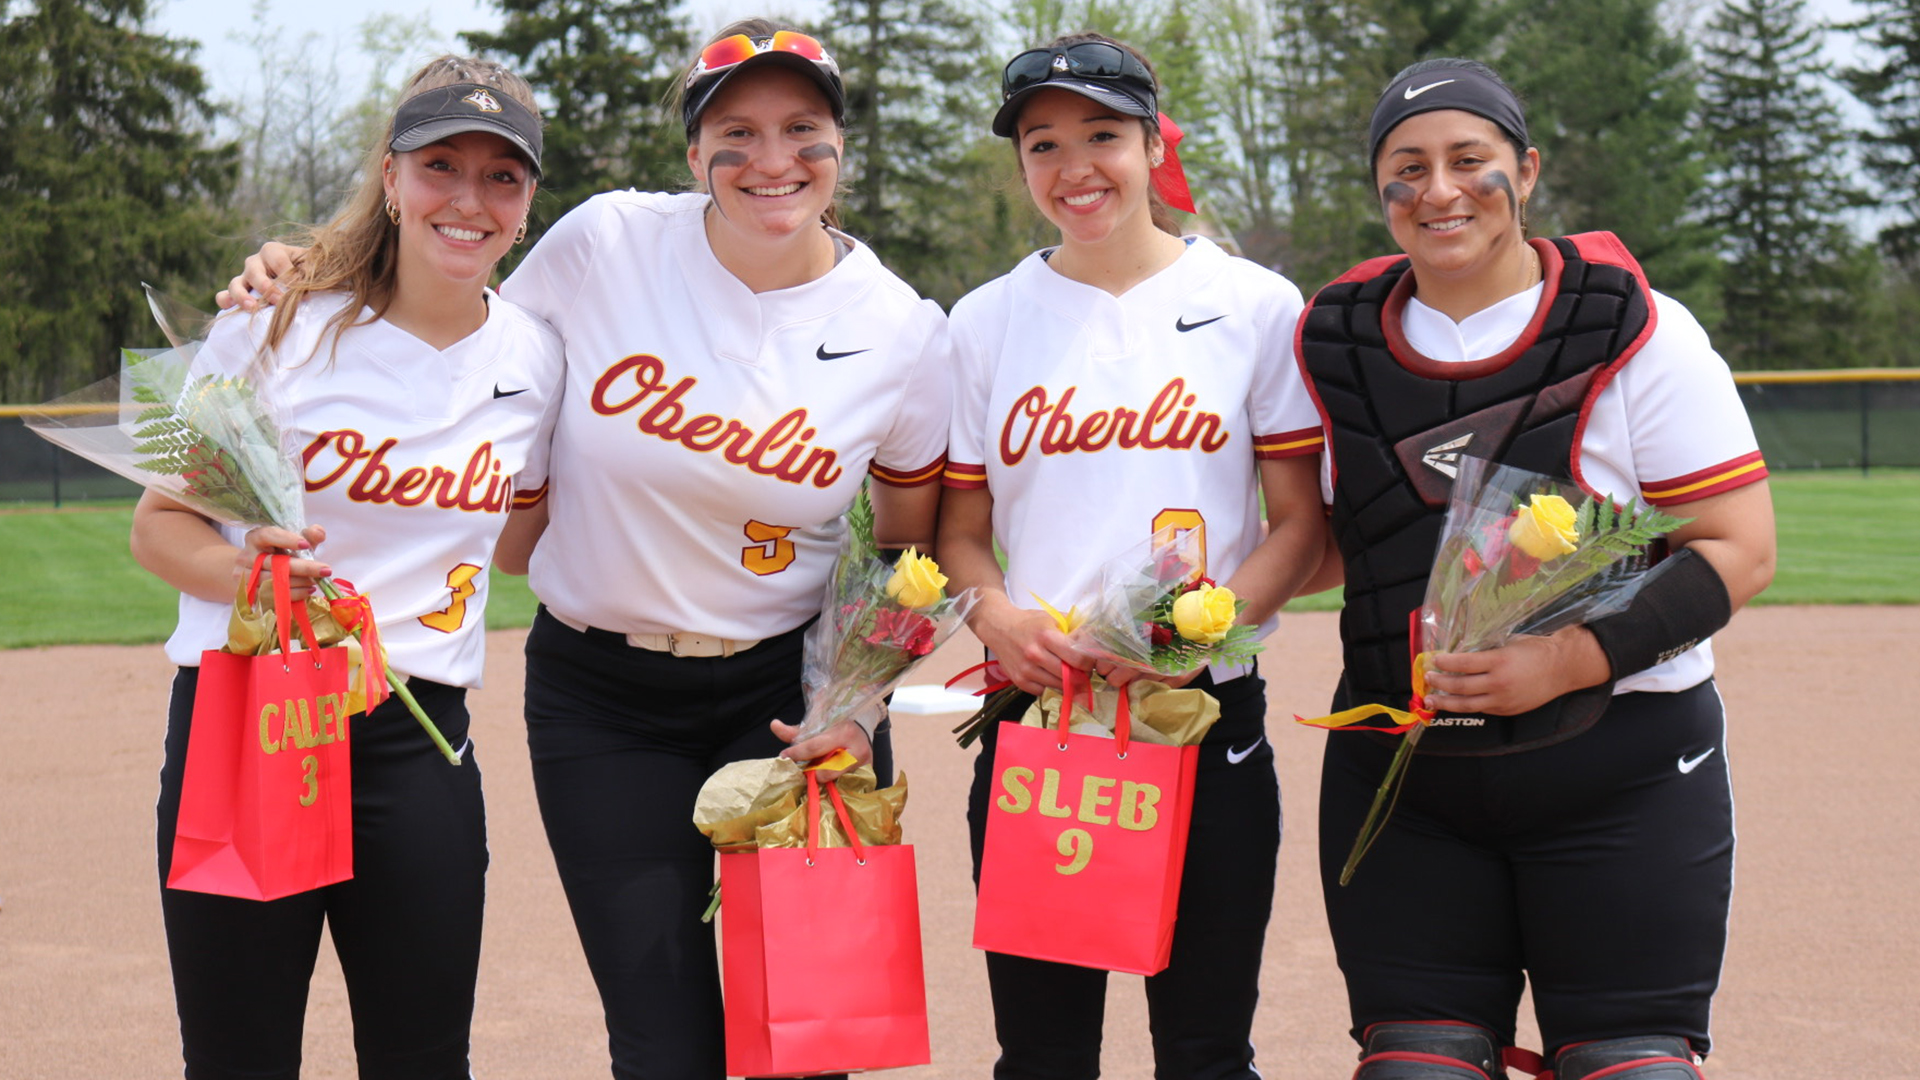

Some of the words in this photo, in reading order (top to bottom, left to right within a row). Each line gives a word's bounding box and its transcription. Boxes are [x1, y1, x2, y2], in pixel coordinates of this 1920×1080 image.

[590, 353, 843, 489] Oberlin
[1000, 376, 1229, 466] Oberlin
[417, 562, 483, 634] 3
[259, 691, 350, 754] CALEY
[1430, 717, 1485, 727] EASTON
[299, 755, 319, 807] 3
[997, 766, 1162, 831] SLEB
[1055, 828, 1094, 875] 9
